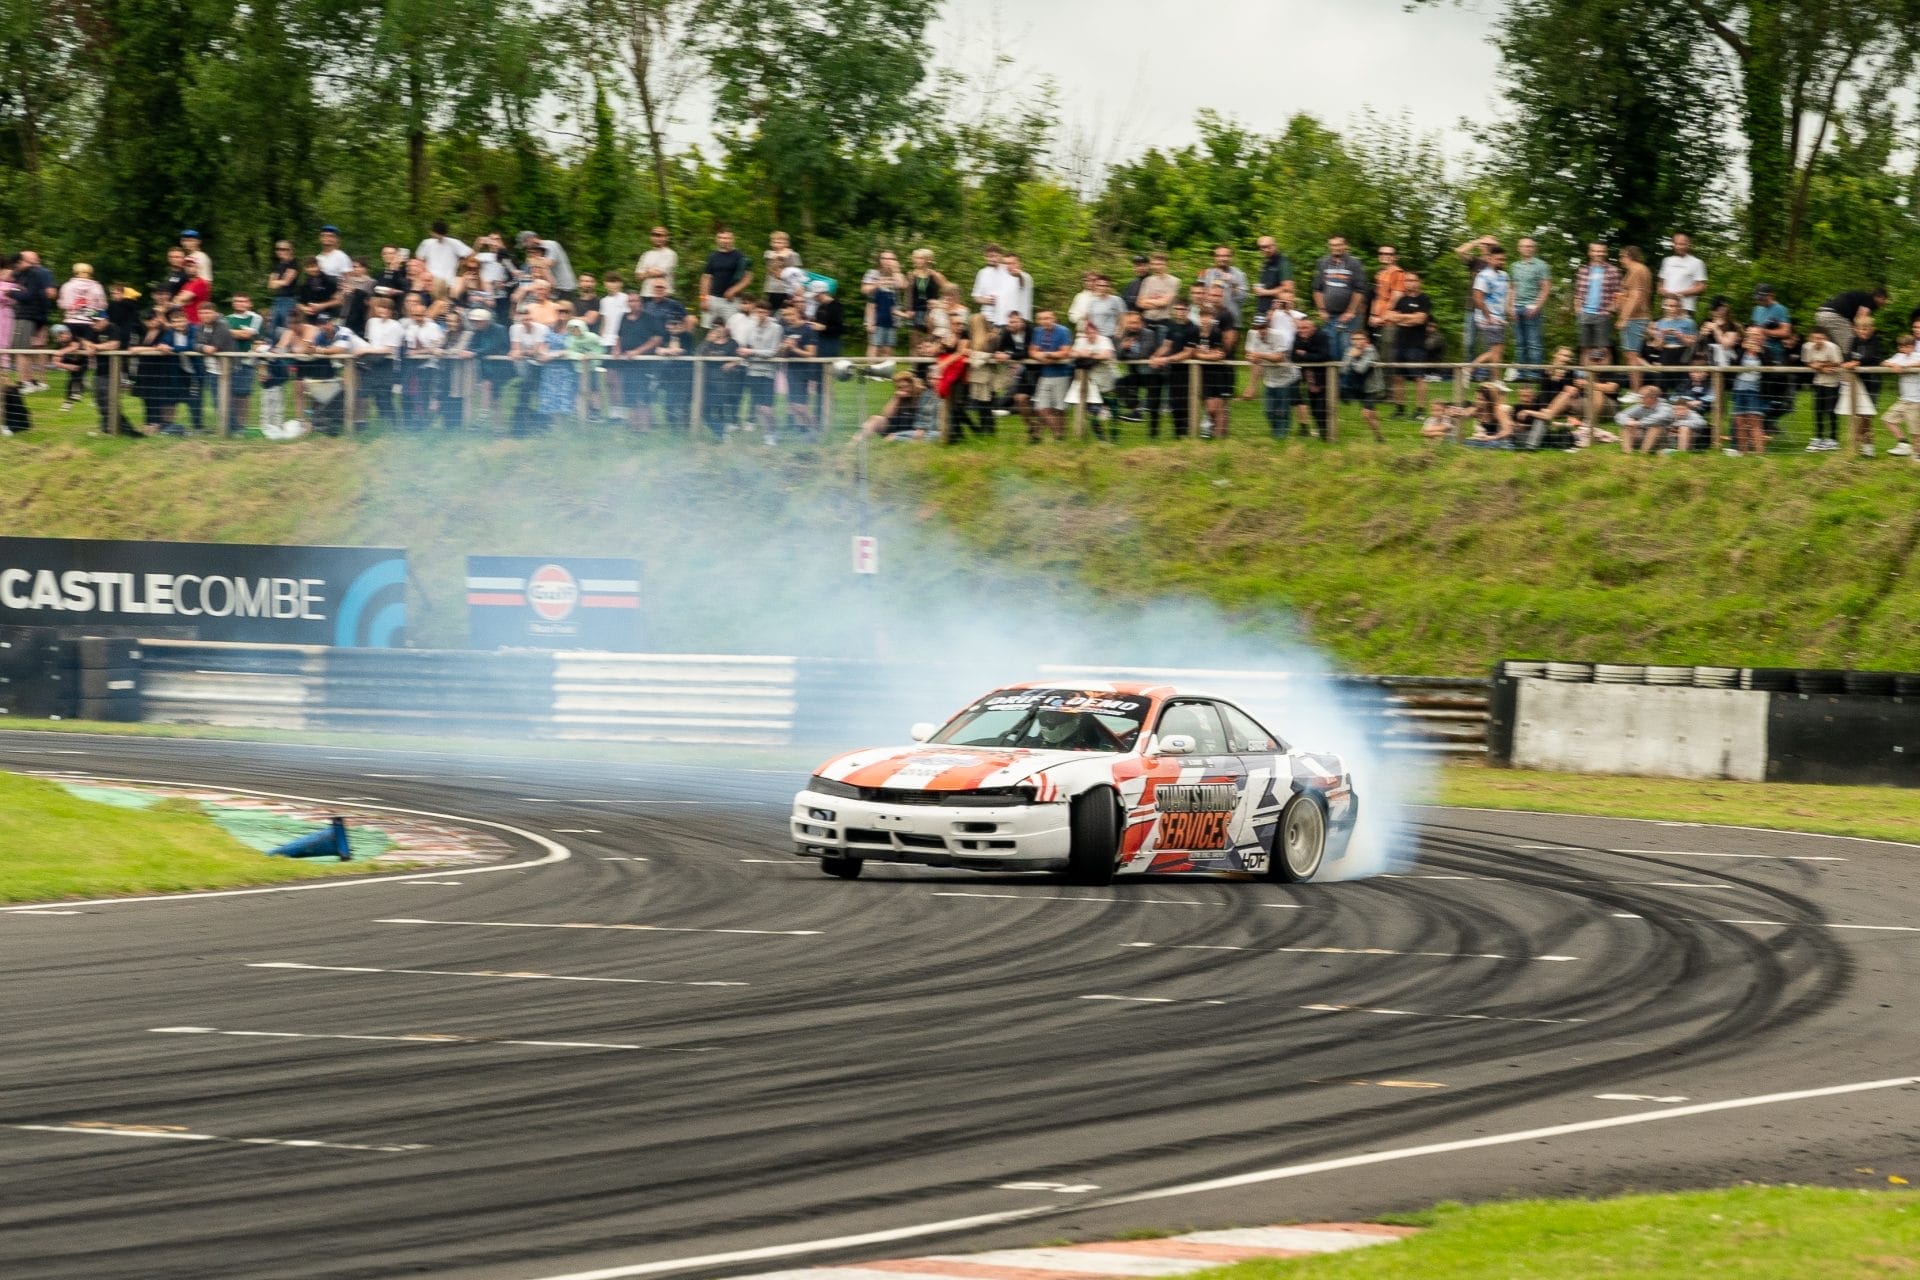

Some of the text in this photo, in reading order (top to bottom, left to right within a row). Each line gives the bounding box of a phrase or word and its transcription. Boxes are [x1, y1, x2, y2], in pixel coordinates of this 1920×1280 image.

[856, 540, 873, 569] F
[1066, 698, 1140, 711] DEMO
[1152, 811, 1233, 850] SERVICES
[1242, 853, 1267, 868] HDF
